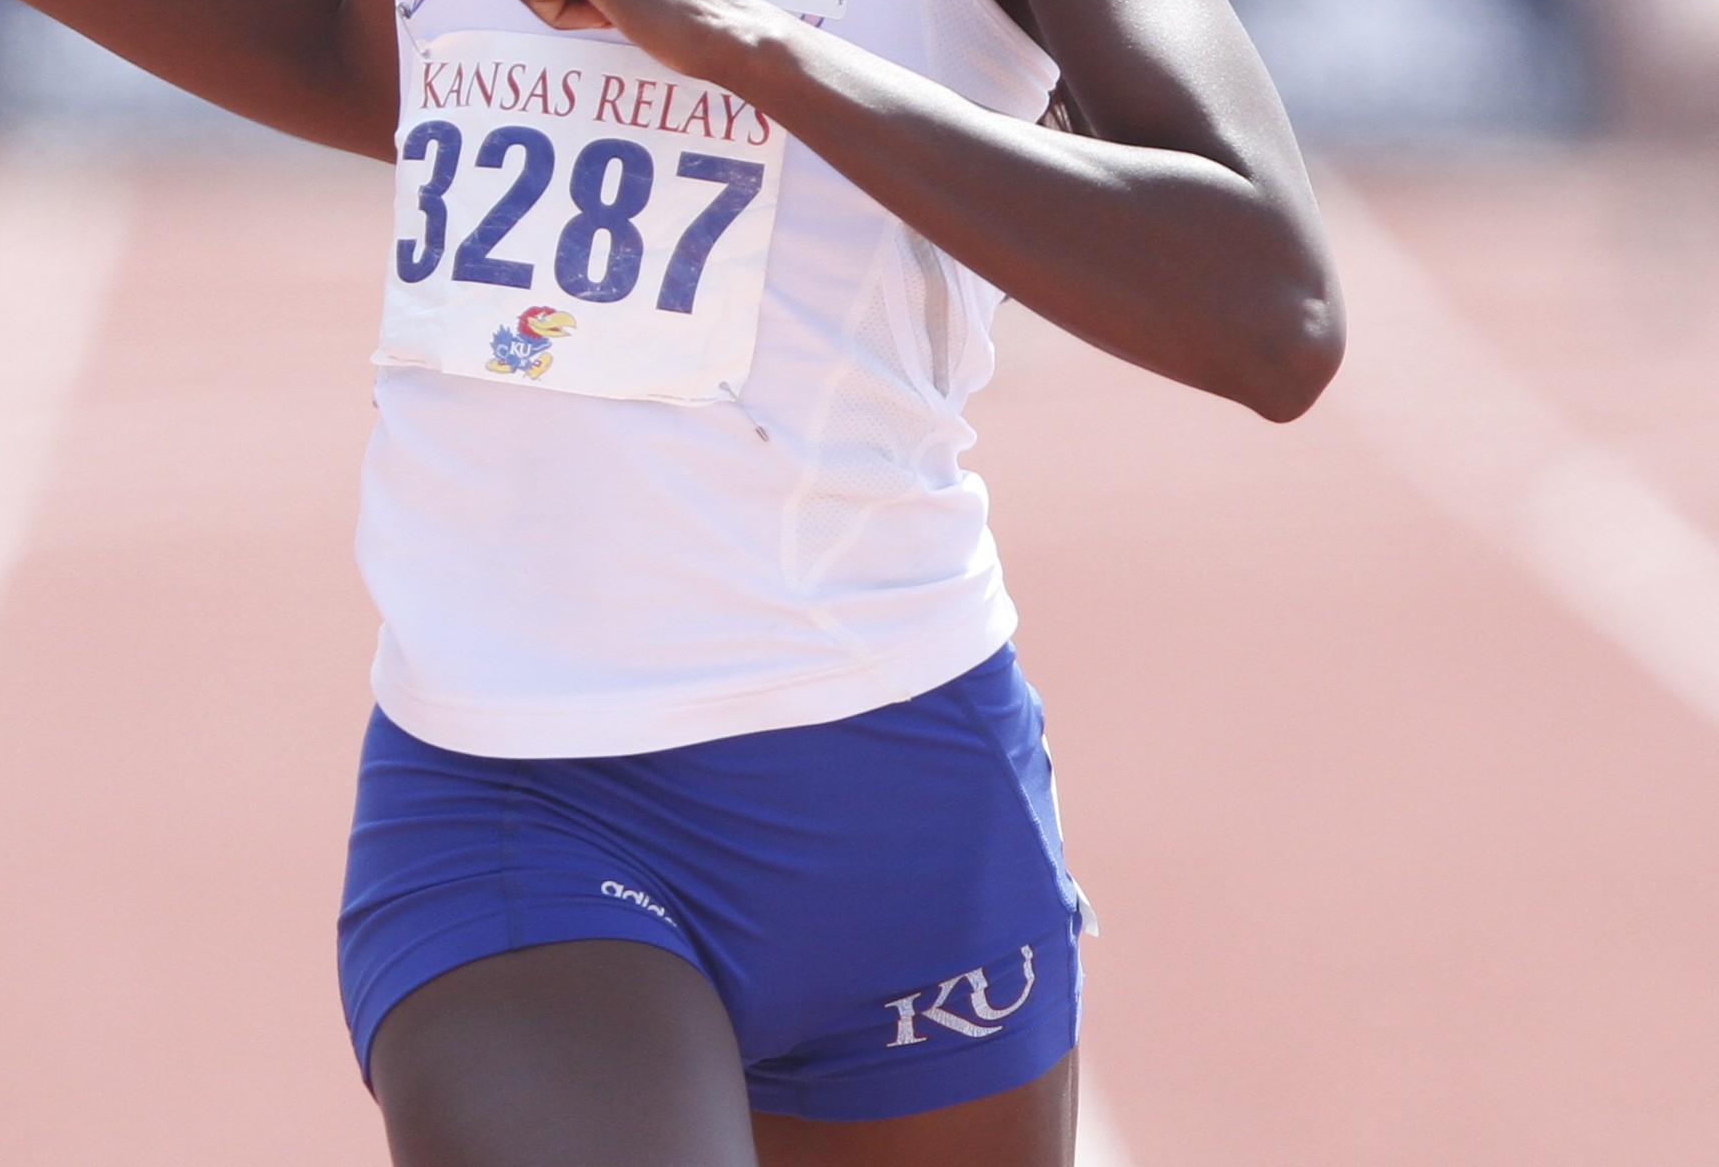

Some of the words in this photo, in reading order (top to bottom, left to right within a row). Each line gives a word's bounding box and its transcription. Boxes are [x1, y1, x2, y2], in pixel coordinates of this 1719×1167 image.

[419, 61, 582, 117] KANSAS
[592, 74, 771, 146] RELAYS
[394, 119, 766, 315] 3287
[509, 340, 533, 360] KU
[884, 944, 1036, 1048] KU
